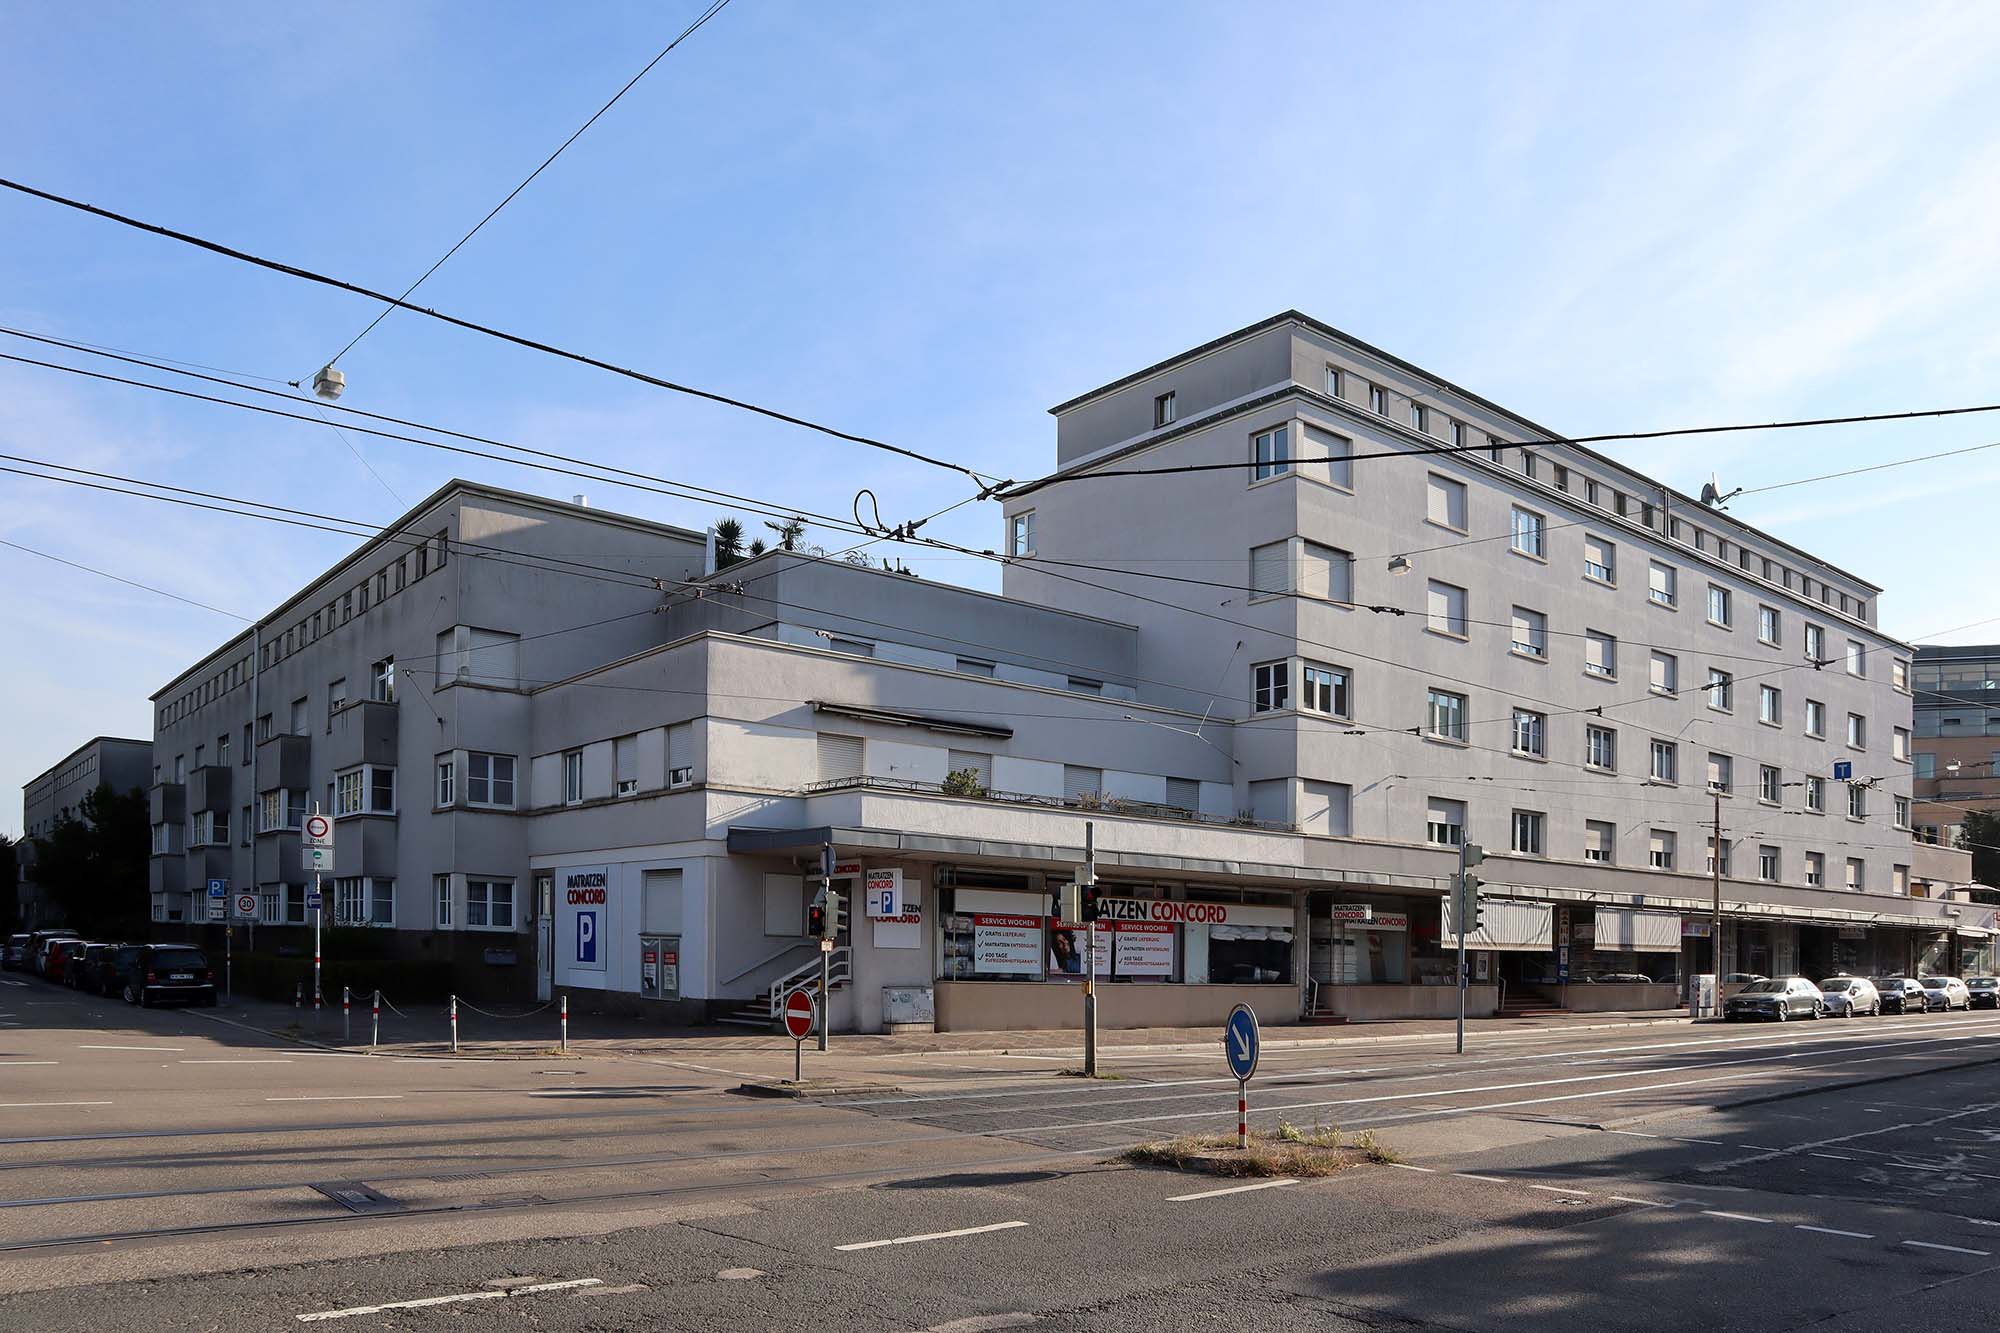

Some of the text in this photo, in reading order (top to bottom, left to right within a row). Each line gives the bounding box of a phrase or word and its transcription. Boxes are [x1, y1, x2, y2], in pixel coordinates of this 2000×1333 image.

[567, 873, 605, 888] MATRATZEN
[868, 872, 893, 880] MATRATZEN
[211, 881, 220, 894] P
[868, 880, 893, 889] CONCORD
[567, 889, 605, 905] CONCORD
[883, 893, 891, 912] P
[242, 900, 252, 908] 30
[1151, 902, 1227, 923] CONCORD
[1334, 911, 1365, 919] CONCORD
[981, 917, 1007, 926] SERVICE
[1120, 923, 1143, 931] SERVICE
[1379, 916, 1407, 927] CONCORD
[580, 915, 593, 959] P
